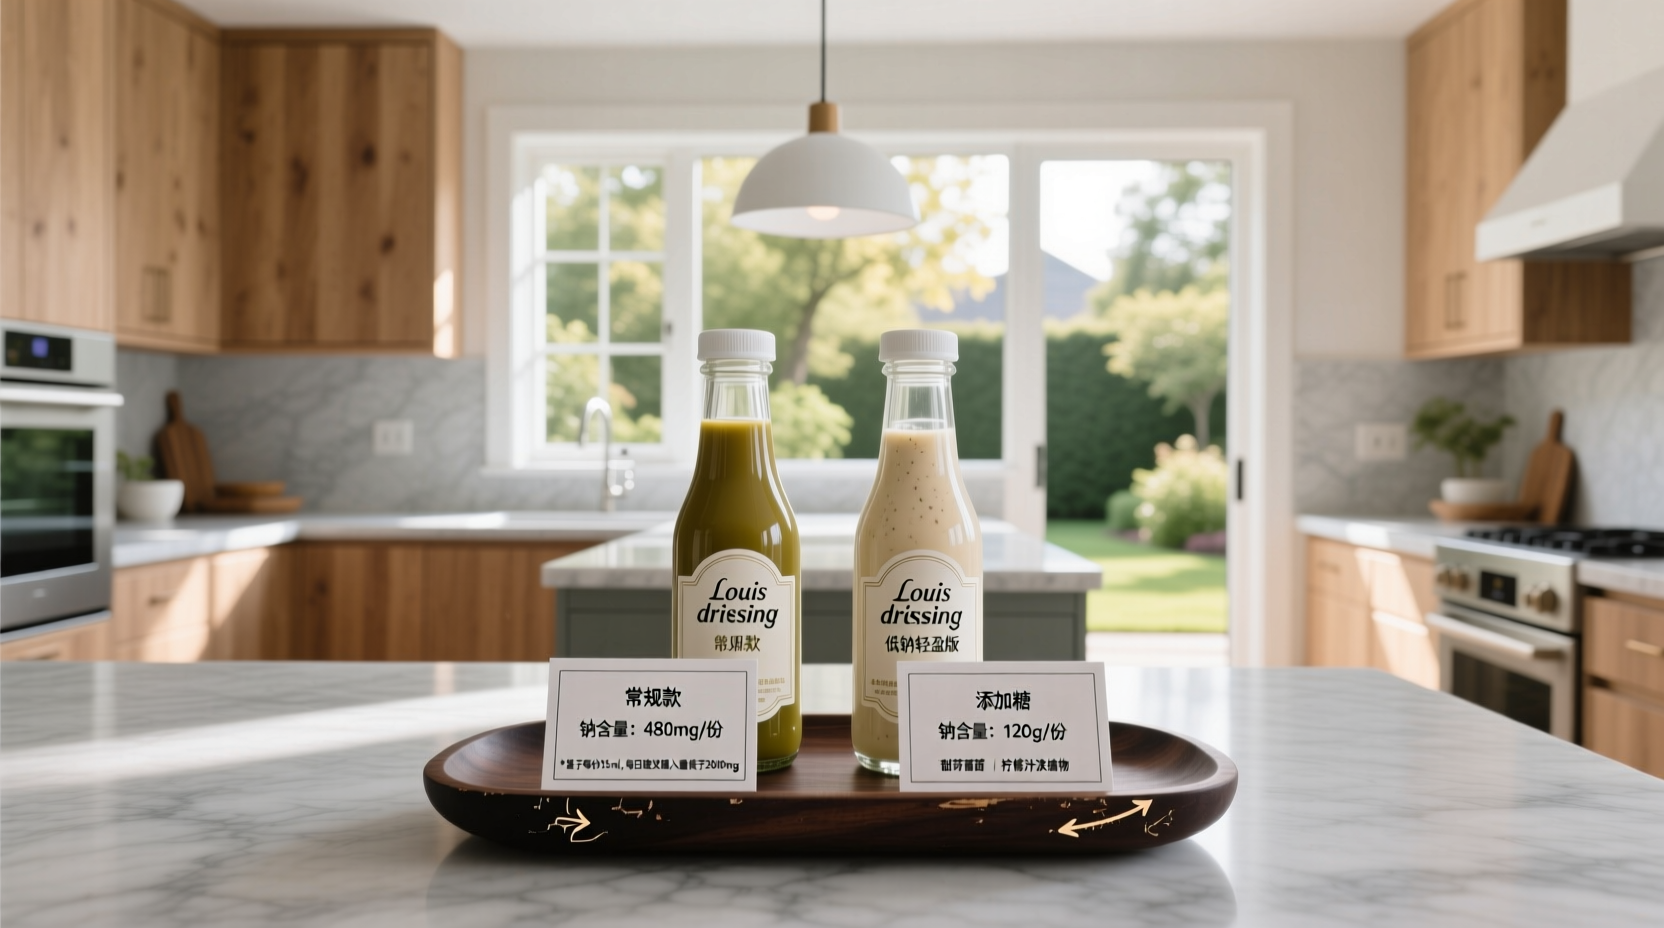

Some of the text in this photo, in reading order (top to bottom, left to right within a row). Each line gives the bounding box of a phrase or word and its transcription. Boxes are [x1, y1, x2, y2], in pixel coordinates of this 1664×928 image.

[708, 577, 768, 601] Louis
[893, 578, 952, 602] Louis
[625, 686, 682, 708] 常规款
[975, 690, 1031, 711] 添加糖
